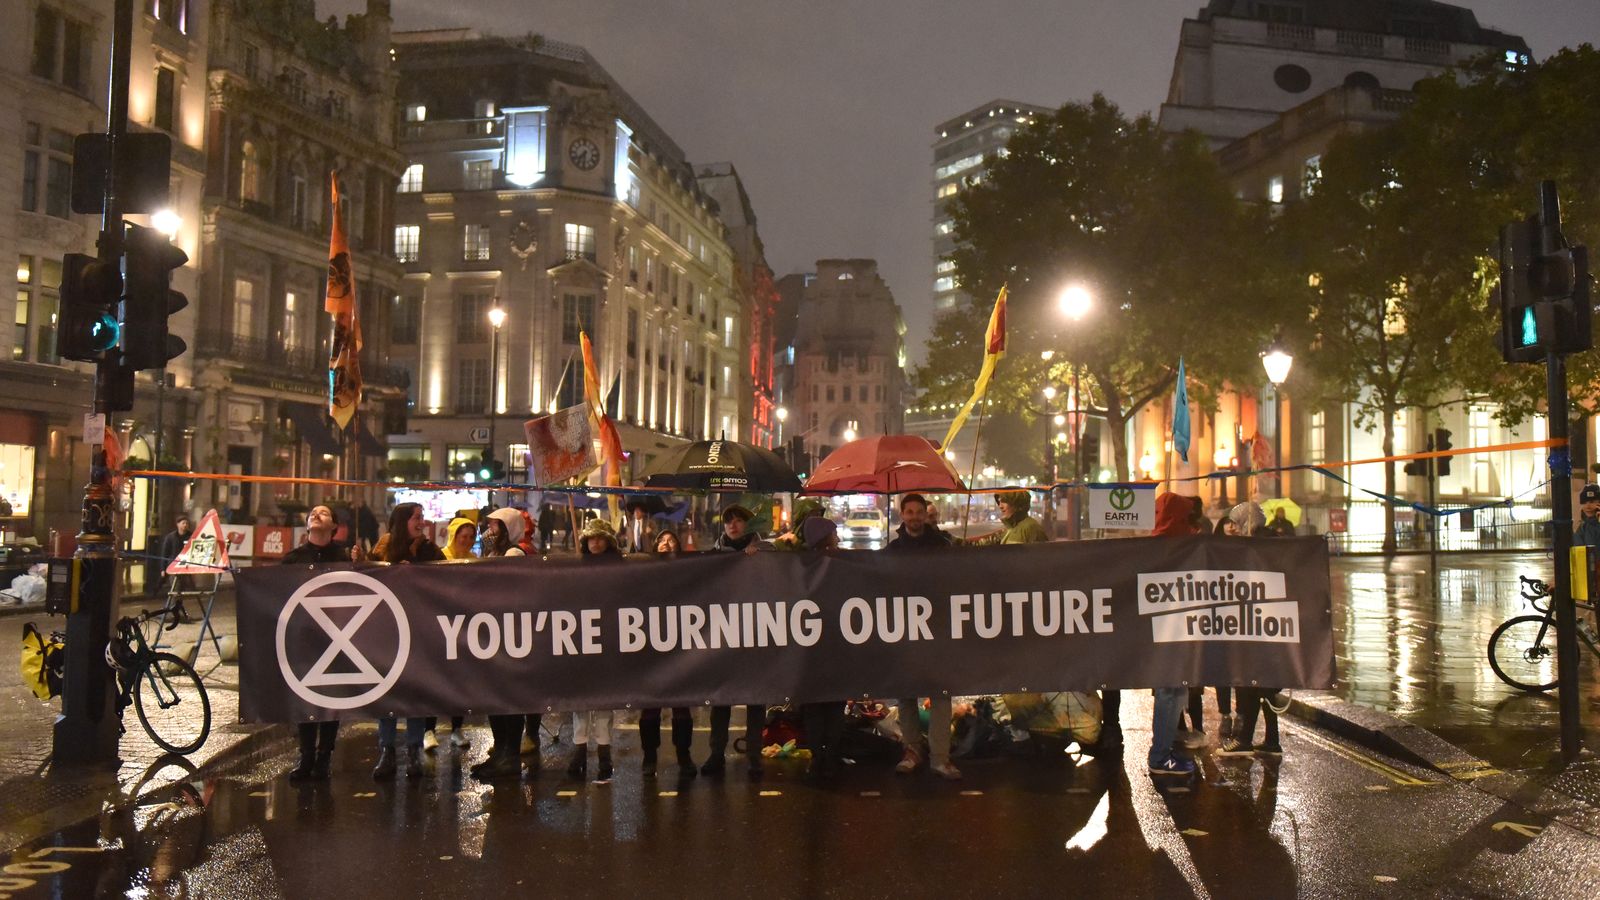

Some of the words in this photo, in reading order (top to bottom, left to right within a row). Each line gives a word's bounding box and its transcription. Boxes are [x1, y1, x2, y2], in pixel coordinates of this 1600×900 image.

[1105, 512, 1138, 520] EARTH
[263, 541, 284, 553] BUCS
[1144, 573, 1266, 603] extinction
[436, 609, 603, 660] YOU'RE
[618, 599, 823, 653] BURNING
[839, 596, 935, 645] OUR
[950, 588, 1114, 639] FUTURE
[1186, 603, 1294, 637] rebellion
